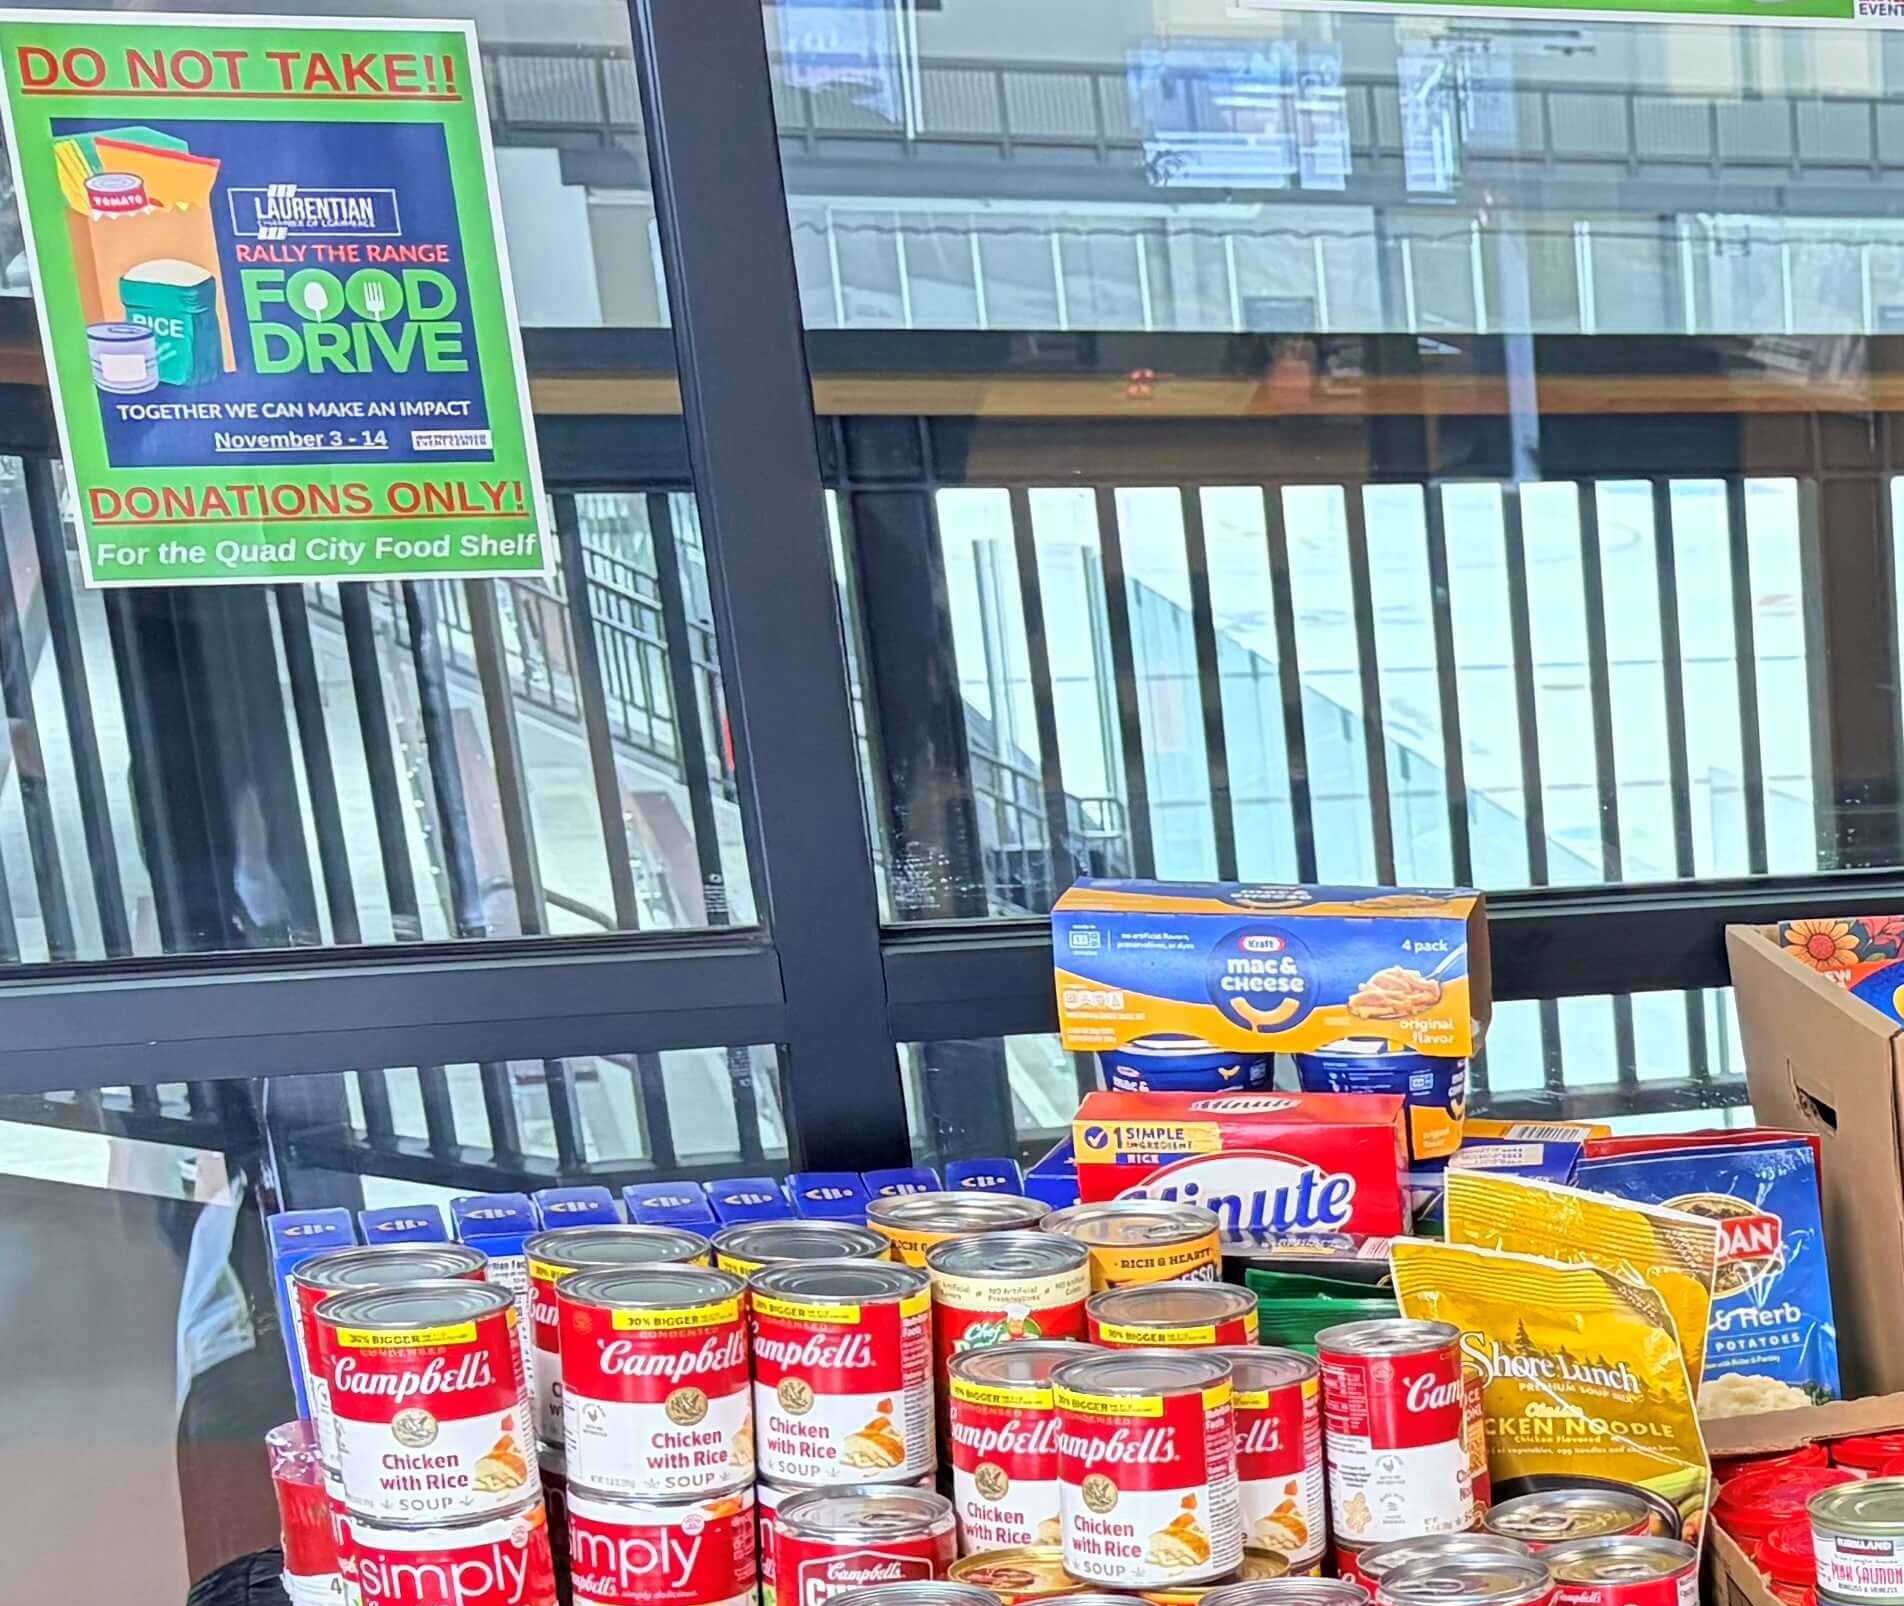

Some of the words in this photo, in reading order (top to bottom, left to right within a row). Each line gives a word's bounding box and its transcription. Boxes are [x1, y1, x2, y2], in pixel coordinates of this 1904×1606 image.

[17, 46, 107, 88] DO
[126, 48, 250, 91] NOT
[265, 51, 457, 95] TAKE!!
[92, 194, 144, 208] TOMATO
[255, 197, 374, 226] LAURENTIAN
[235, 244, 306, 263] RALLY
[311, 244, 360, 263] THE
[367, 244, 450, 263] RANGE
[240, 268, 457, 322] FOOD
[249, 321, 469, 374] DRIVE
[117, 403, 222, 421] TOGETHER
[226, 403, 258, 420] WE
[262, 403, 304, 419] CAN
[307, 402, 364, 419] MAKE
[367, 401, 397, 418] AN
[399, 400, 471, 418] IMPACT
[215, 430, 325, 450] November
[330, 431, 342, 446] 3
[362, 431, 387, 446] 14
[89, 482, 372, 520] DONATIONS
[387, 480, 525, 514] ONLY!
[98, 542, 150, 568] For
[157, 541, 206, 564] the
[215, 539, 297, 563] Quad
[305, 537, 366, 564] City
[375, 535, 451, 559] Food
[459, 532, 537, 556] Shelf
[1248, 938, 1275, 949] Kraft
[1401, 939, 1412, 950] 4
[1414, 939, 1449, 953] pack
[1126, 1127, 1185, 1141] SIMPLE
[1715, 1333, 1800, 1352] POTATOES
[1460, 1331, 1555, 1389] Shore
[1557, 1353, 1641, 1394] Lunch
[330, 1349, 496, 1404] Campbell's
[1566, 1417, 1675, 1439] NOODLE
[382, 1453, 459, 1471] Chicken
[380, 1475, 422, 1492] with
[426, 1472, 469, 1490] Rice
[400, 1496, 453, 1512] SOUP
[1074, 1514, 1135, 1537] Chicken
[1072, 1536, 1101, 1555] with
[1104, 1539, 1142, 1558] Rice
